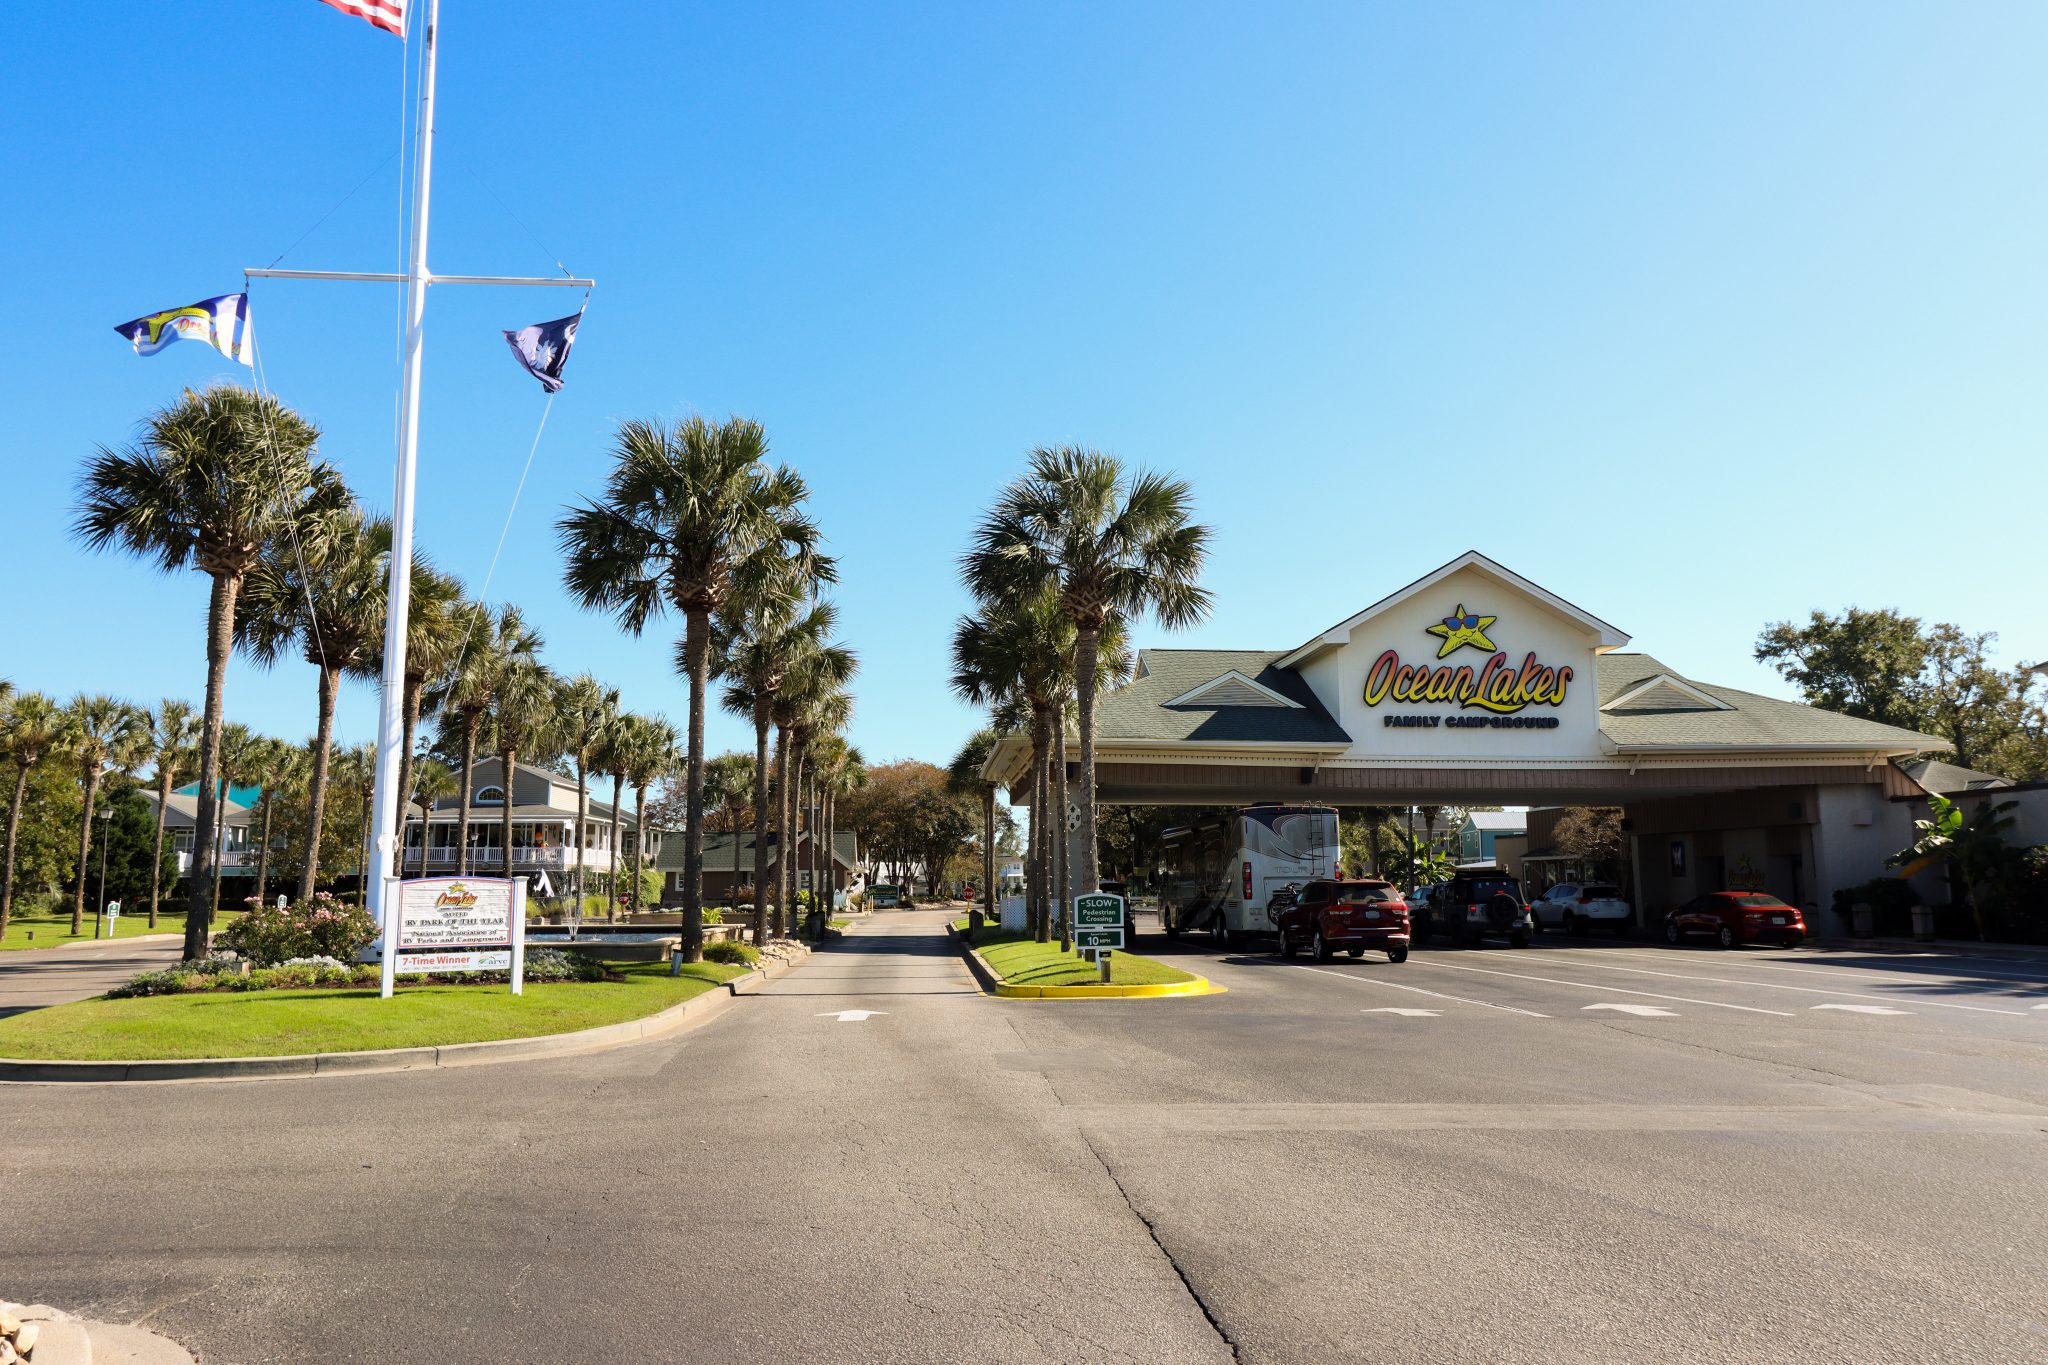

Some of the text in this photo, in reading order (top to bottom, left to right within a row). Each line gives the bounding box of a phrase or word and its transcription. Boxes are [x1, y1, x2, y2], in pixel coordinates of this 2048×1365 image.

[1364, 649, 1574, 714] Ocean Lakes
[1384, 715, 1560, 729] FAMILY CAMPGROUND
[456, 935, 506, 943] Campgrounds
[1087, 936, 1099, 946] 10
[402, 956, 471, 966] 7-Time Winner
